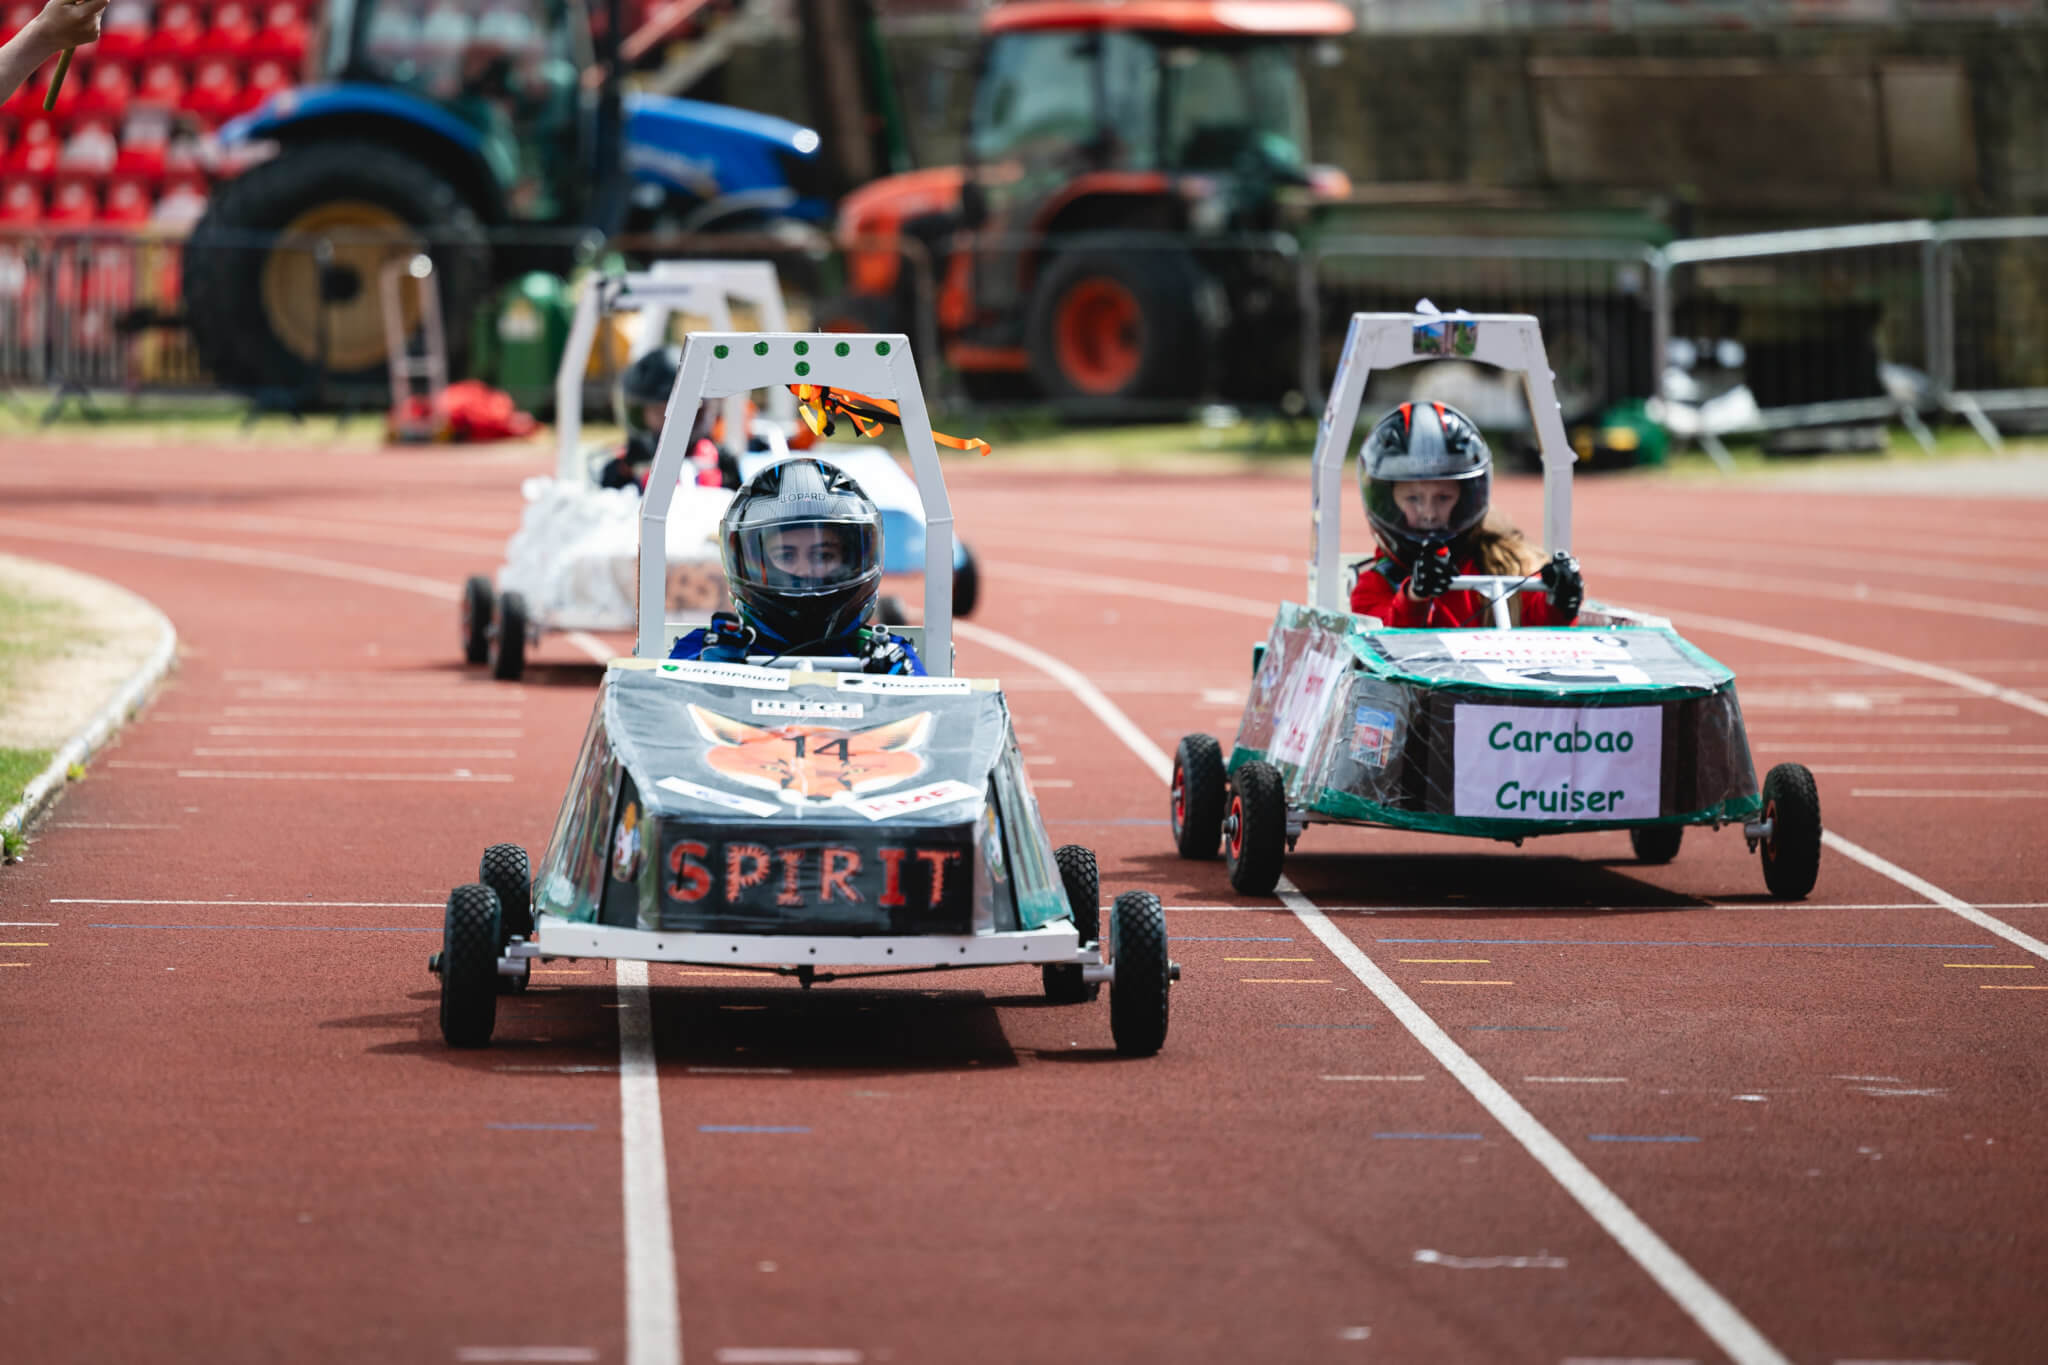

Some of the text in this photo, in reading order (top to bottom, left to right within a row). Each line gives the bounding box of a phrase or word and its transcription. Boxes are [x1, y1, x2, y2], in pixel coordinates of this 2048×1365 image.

[682, 666, 786, 683] GREENPOWER
[780, 734, 857, 761] 14
[1487, 721, 1634, 754] Carabao
[1495, 780, 1625, 813] Cruiser
[666, 841, 962, 907] SPIRIT
